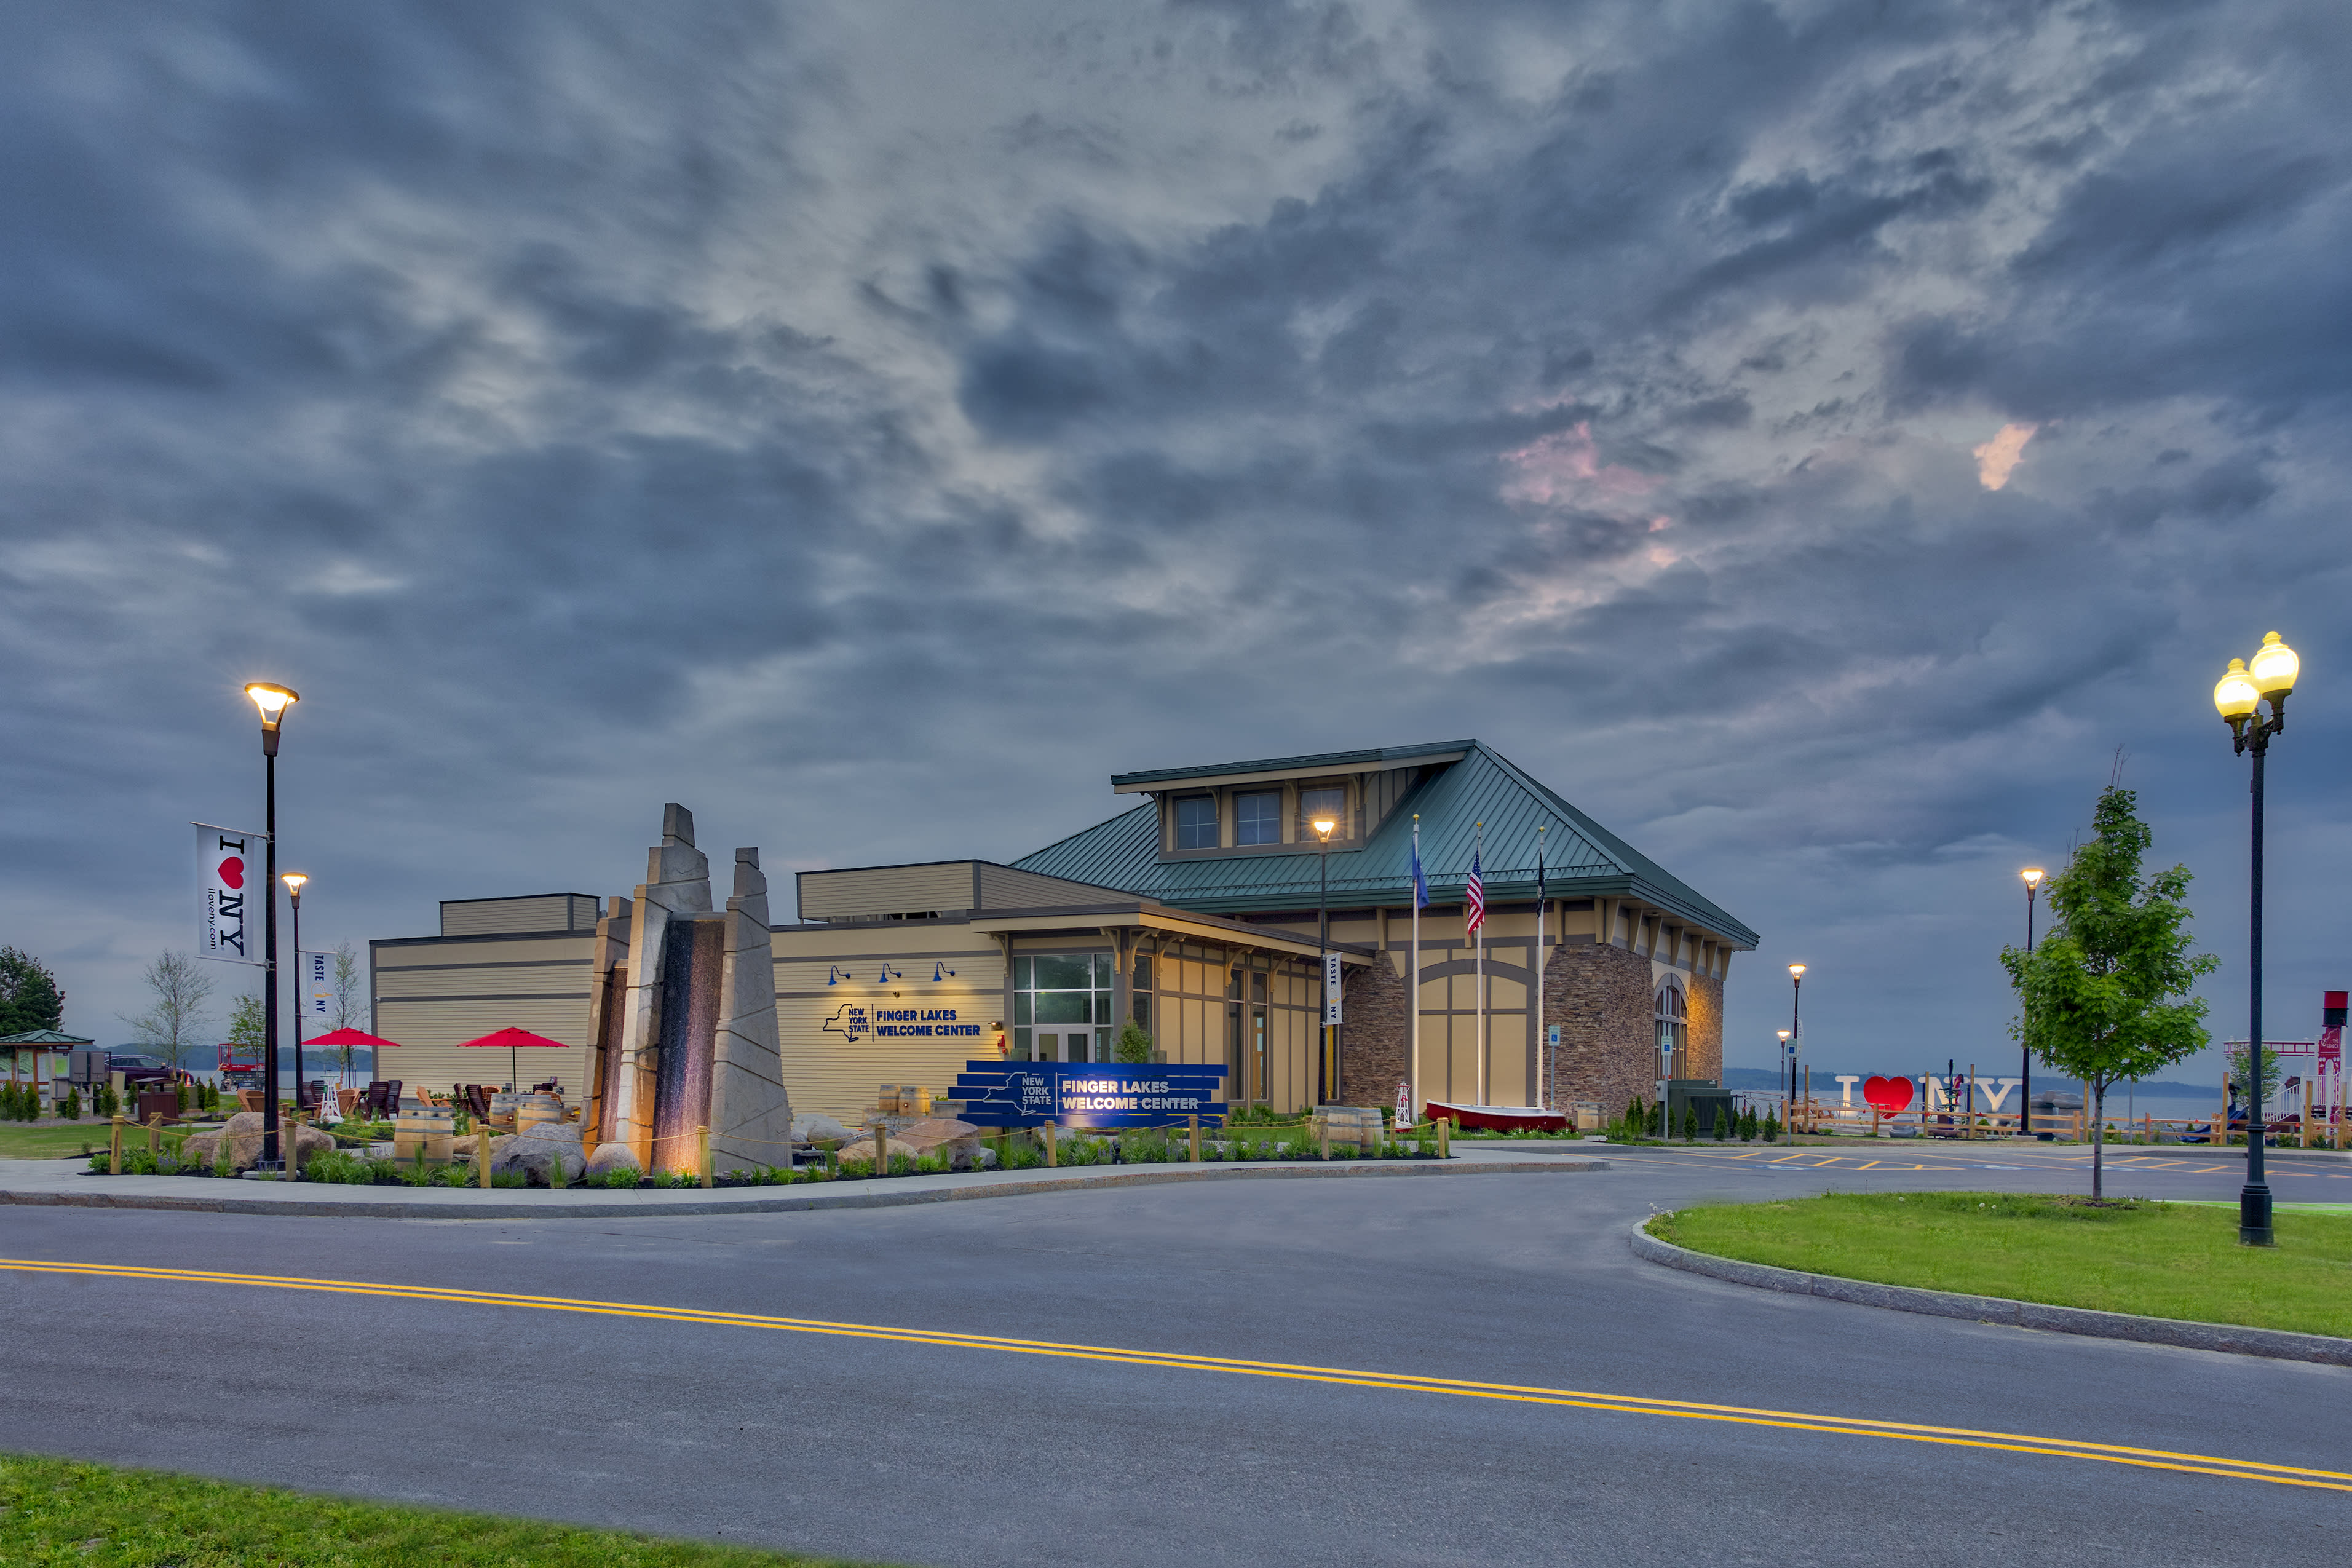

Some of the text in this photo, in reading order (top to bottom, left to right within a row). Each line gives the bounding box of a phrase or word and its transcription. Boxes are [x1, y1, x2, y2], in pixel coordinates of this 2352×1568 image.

[219, 835, 245, 957] I NY
[208, 887, 216, 950] iloveny.com
[314, 954, 325, 1012] TASTE NY
[876, 1010, 957, 1021] FINGER LAKES
[1331, 1005, 1336, 1019] NY
[876, 1024, 981, 1037] WELCOME CENTER
[1022, 1077, 1044, 1086] NEW
[1062, 1080, 1169, 1093] FINGER LAKES
[1022, 1087, 1049, 1095] YORK
[1022, 1096, 1051, 1104] STATE
[1062, 1097, 1198, 1110] WELCOME CENTER
